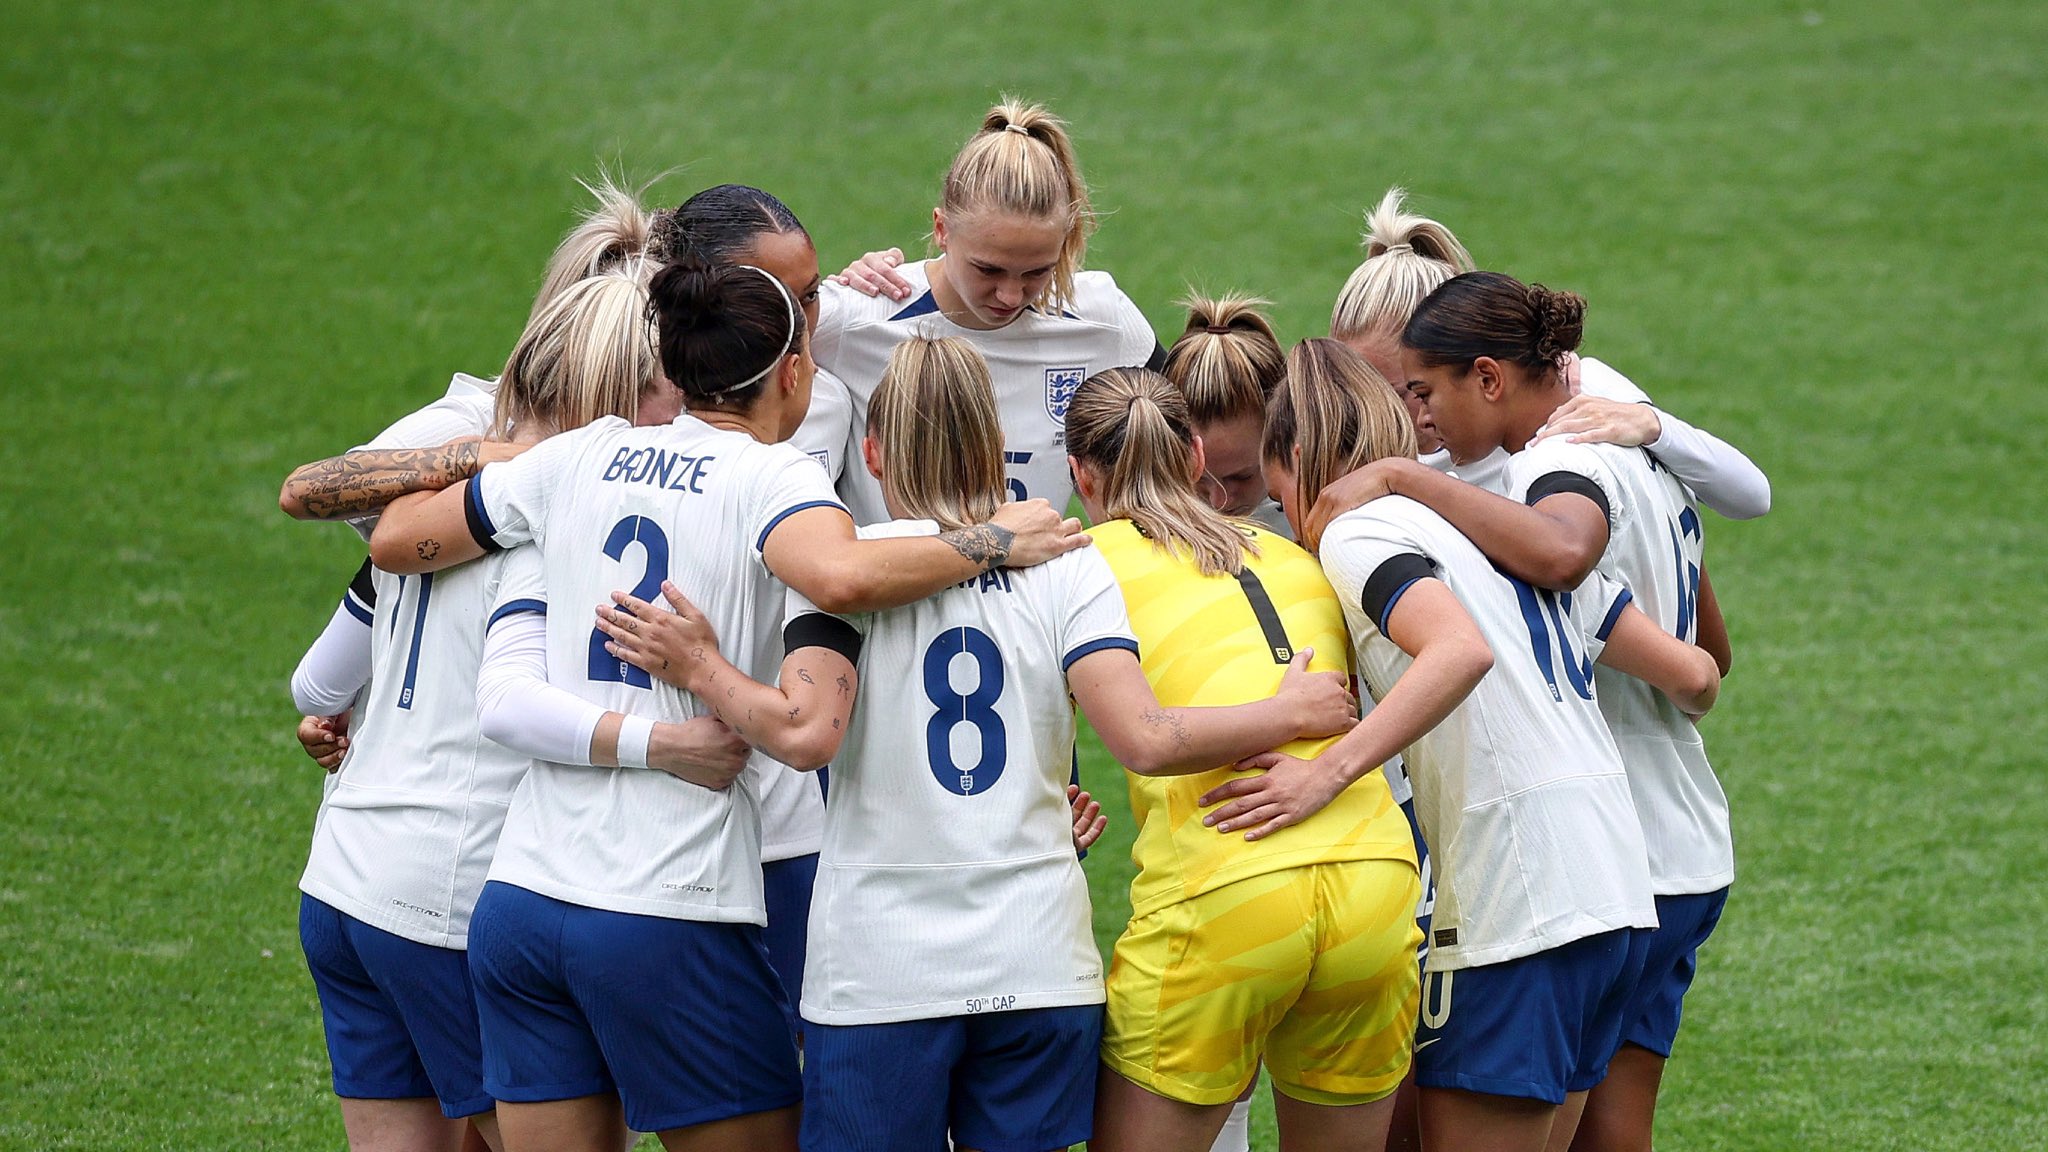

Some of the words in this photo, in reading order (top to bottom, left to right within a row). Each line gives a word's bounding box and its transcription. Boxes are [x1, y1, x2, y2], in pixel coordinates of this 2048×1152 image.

[602, 446, 717, 494] BRONZE
[588, 514, 670, 691] 2
[1232, 565, 1295, 665] 1
[923, 625, 1007, 797] 8
[992, 995, 1016, 1010] CAP
